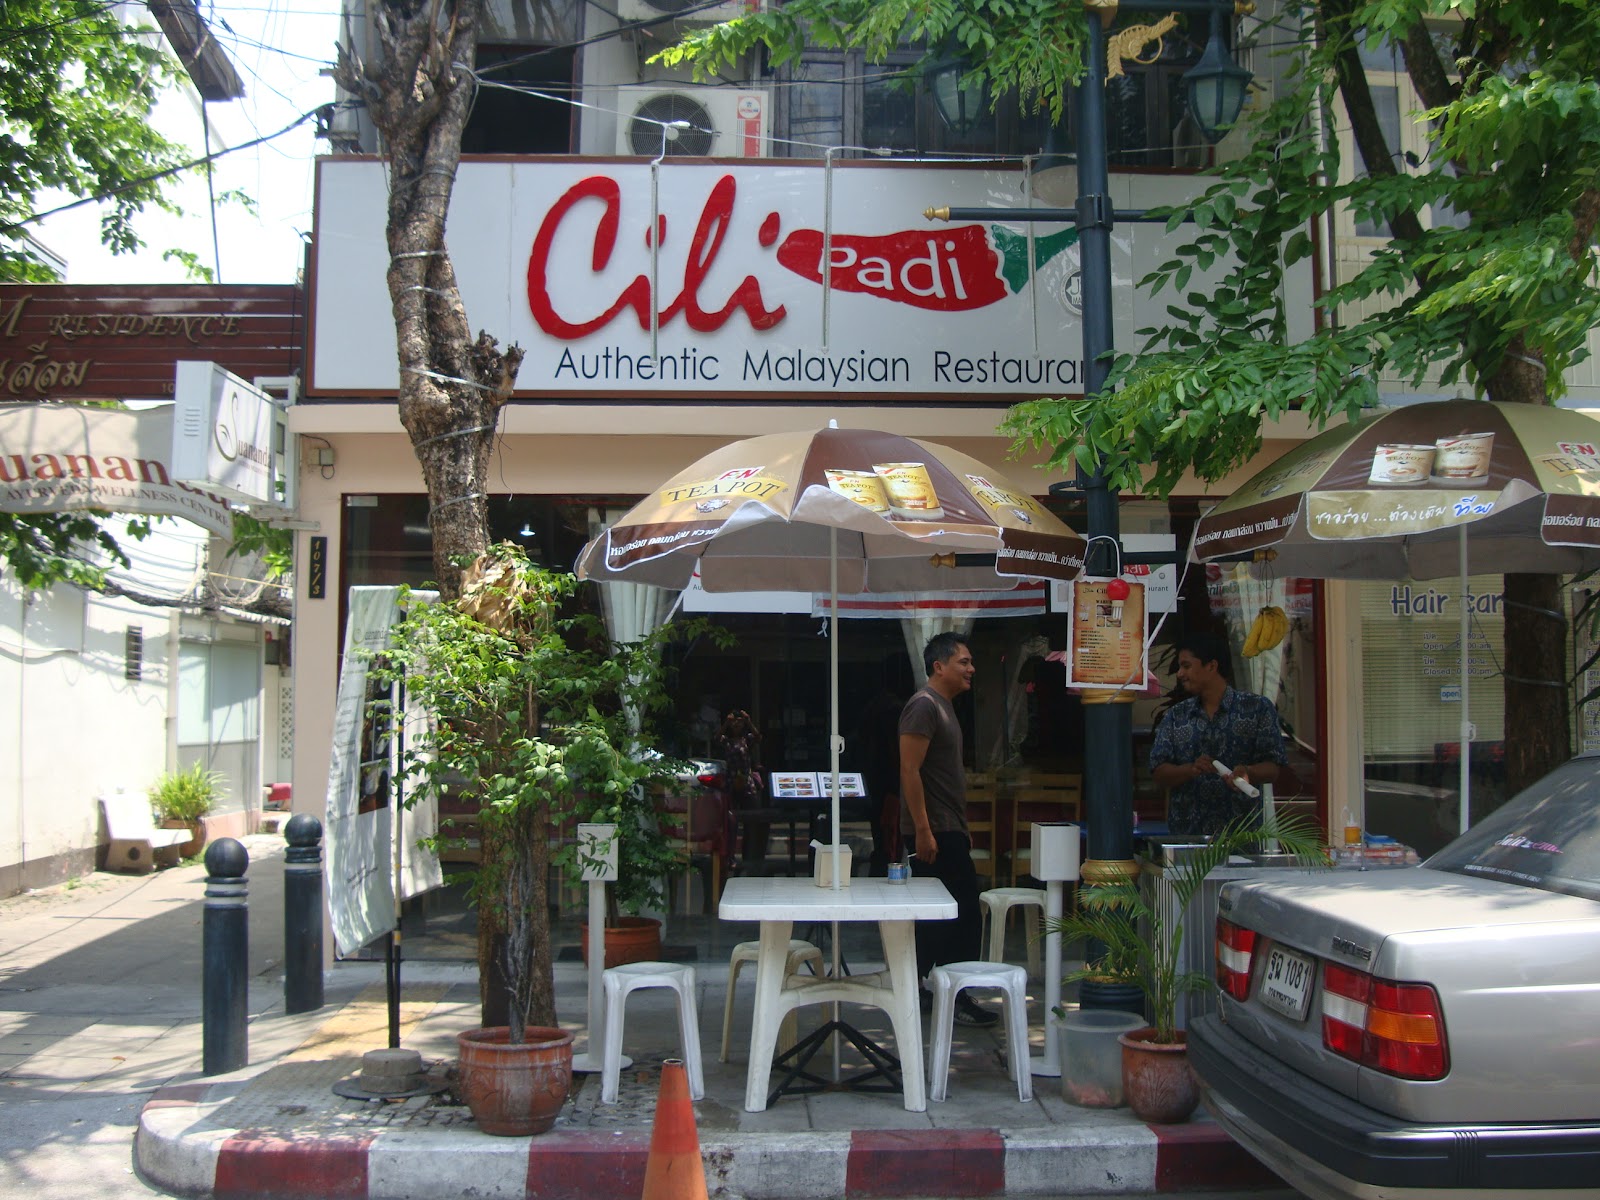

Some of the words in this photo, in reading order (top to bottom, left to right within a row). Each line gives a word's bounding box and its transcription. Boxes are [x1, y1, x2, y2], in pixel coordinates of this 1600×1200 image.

[527, 174, 788, 340] Cili
[817, 240, 968, 300] Padi
[50, 315, 241, 343] RESIDENCE
[554, 346, 719, 380] Authentic
[742, 348, 910, 385] Malaysian
[934, 350, 1084, 385] Restaura
[1542, 458, 1594, 473] TEA
[94, 484, 177, 503] WELLNESS
[179, 496, 229, 526] CENTRE
[667, 483, 719, 502] TEA
[726, 480, 781, 497] POT
[312, 540, 321, 595] 107/3
[1391, 586, 1448, 614] Hair
[1423, 642, 1444, 650] Open
[1423, 667, 1451, 675] Closed
[1441, 690, 1460, 698] open
[1284, 958, 1310, 993] 1081
